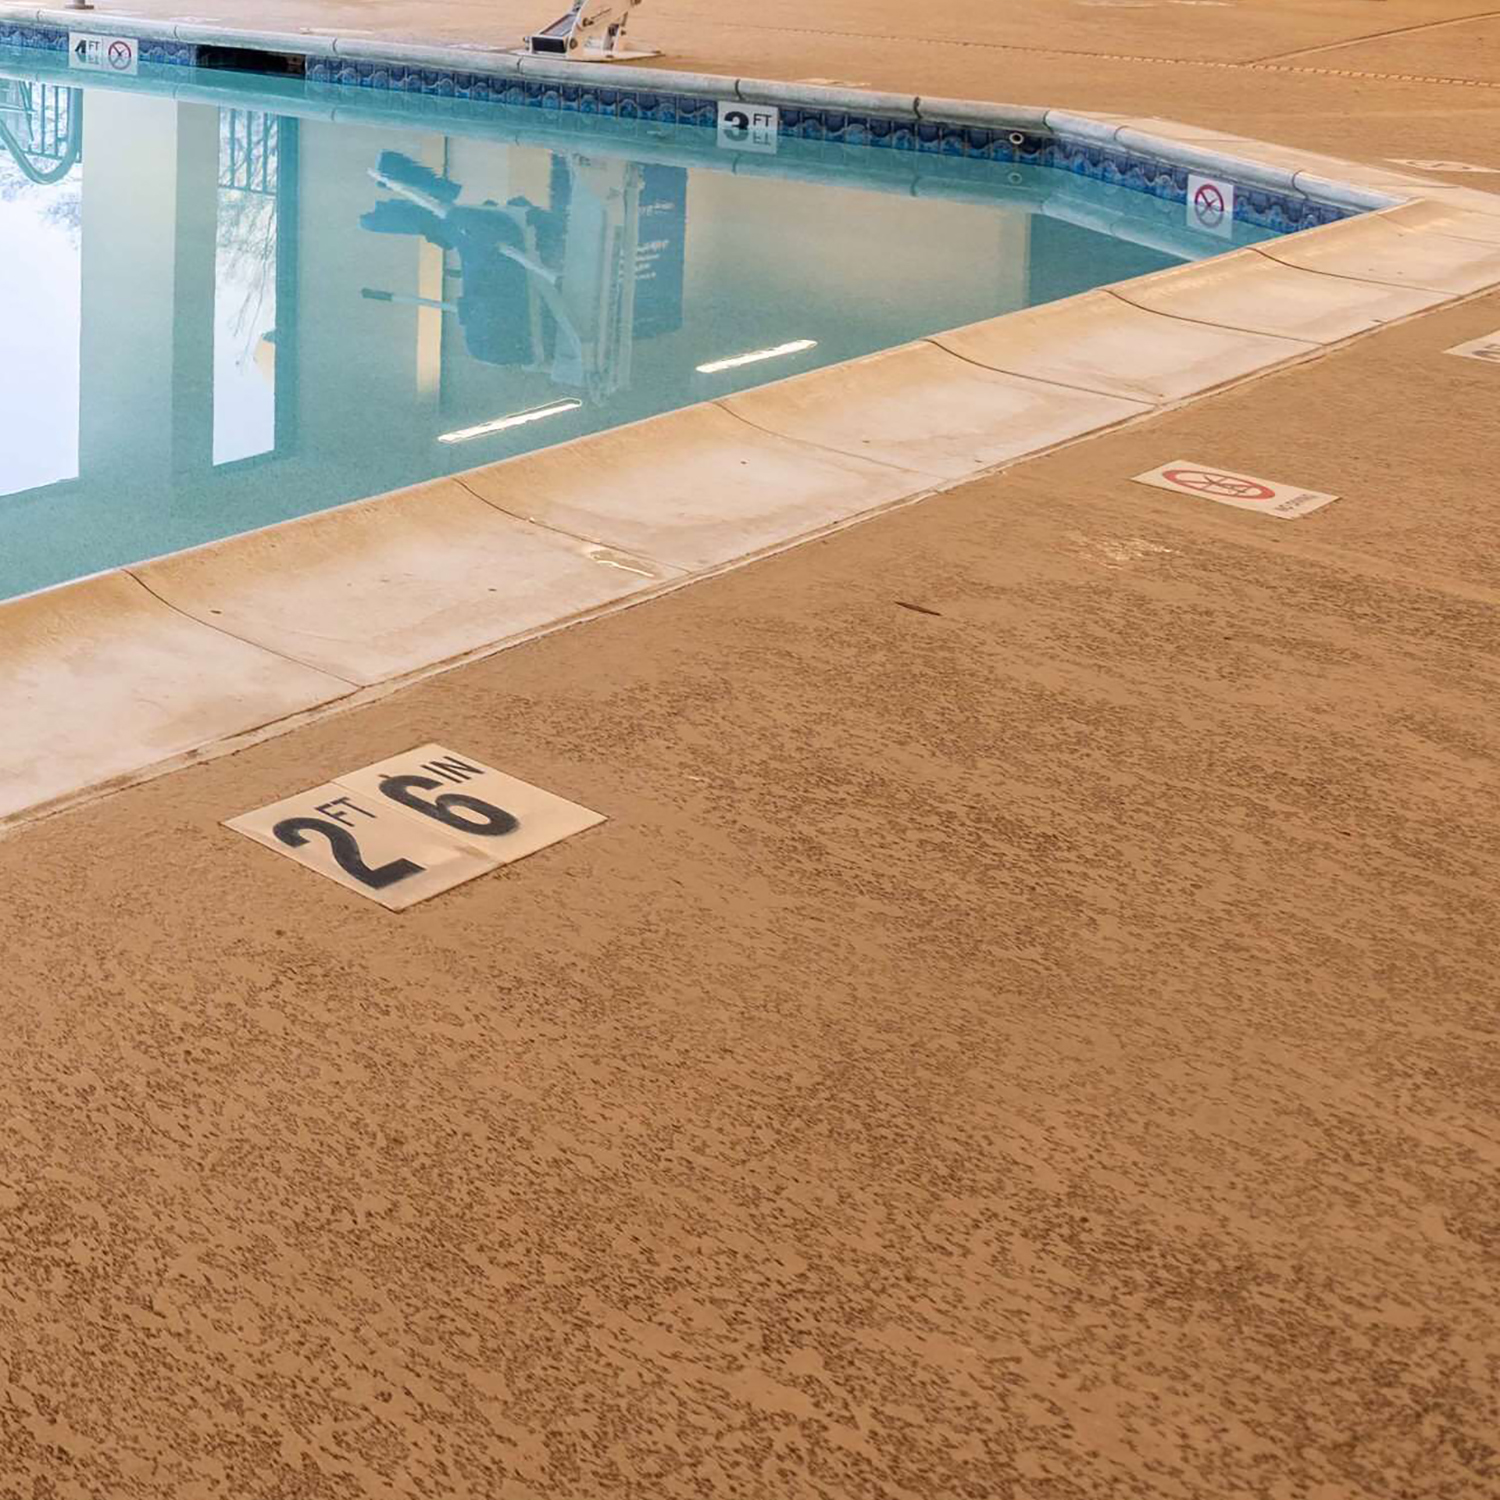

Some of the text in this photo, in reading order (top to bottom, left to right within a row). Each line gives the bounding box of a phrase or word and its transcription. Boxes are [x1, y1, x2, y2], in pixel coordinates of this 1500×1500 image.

[753, 113, 771, 127] FT
[272, 756, 521, 890] 2 FT 6 IN
